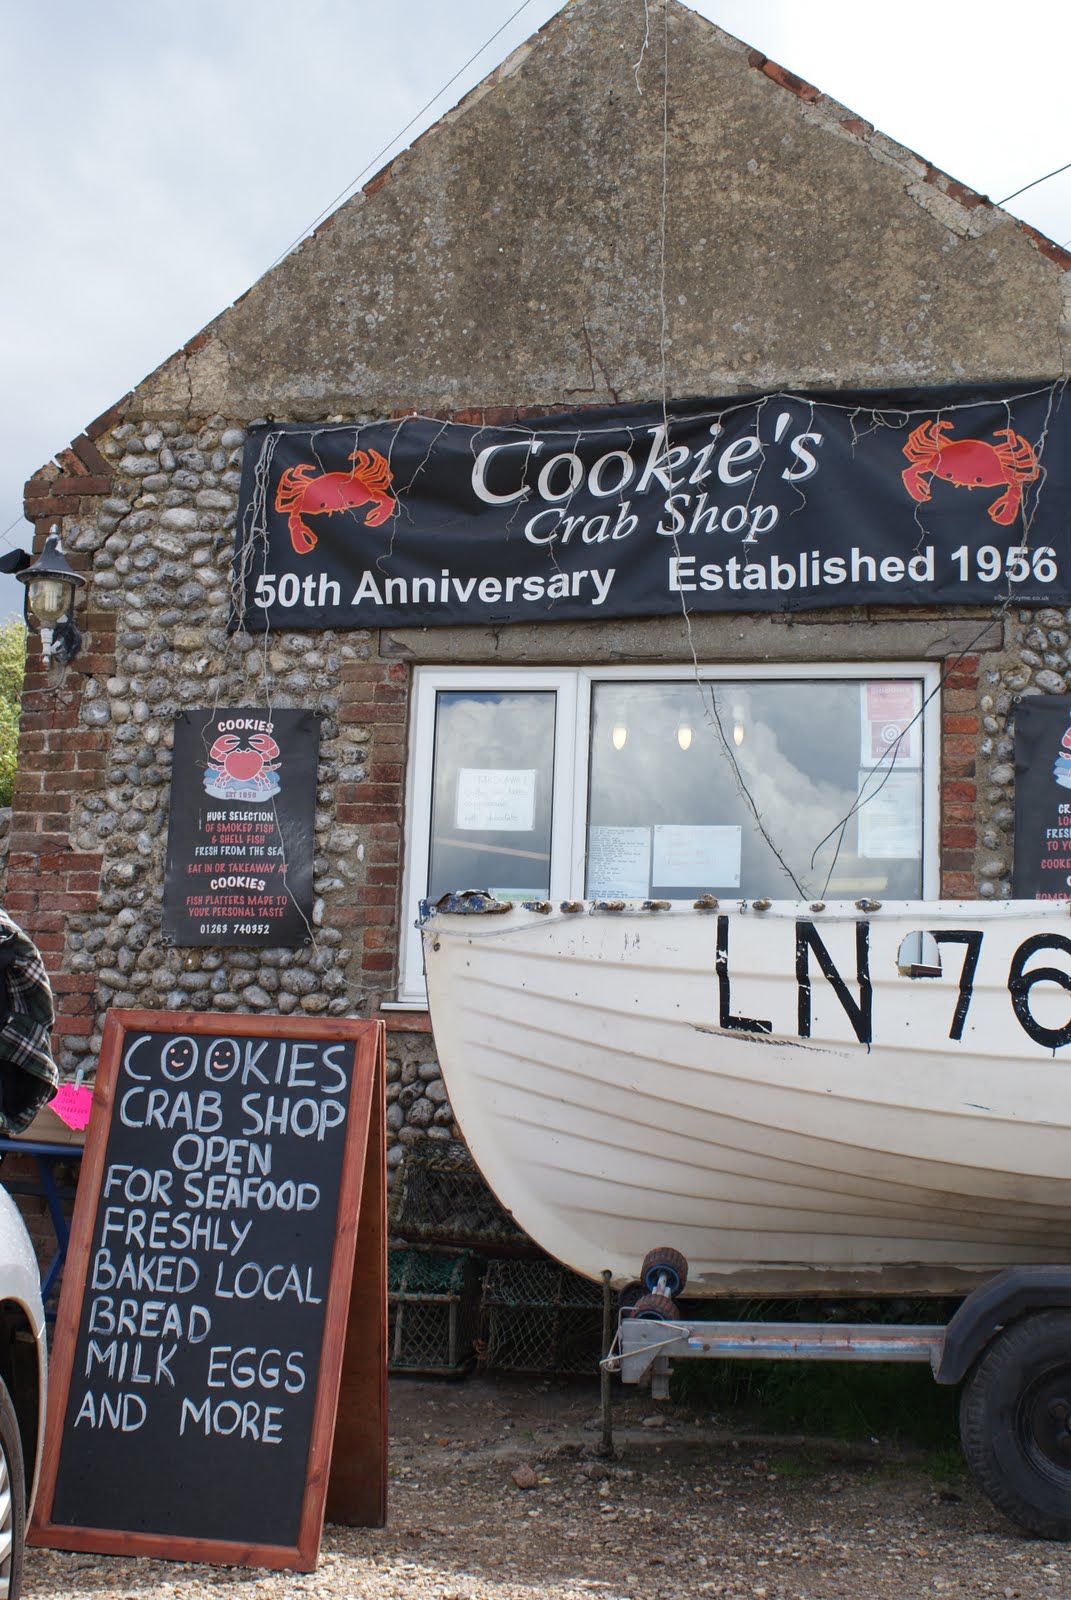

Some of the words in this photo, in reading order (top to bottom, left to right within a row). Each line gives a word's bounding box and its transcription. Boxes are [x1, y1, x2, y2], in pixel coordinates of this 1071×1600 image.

[471, 412, 824, 506] Cookie's
[523, 501, 639, 545] Crab
[656, 493, 779, 543] Shop
[253, 572, 341, 608] 50th
[352, 568, 616, 605] Anniversary
[668, 545, 935, 592] Established
[950, 545, 1058, 583] 1956
[217, 718, 274, 734] COOKIES
[205, 823, 214, 833] OF
[216, 823, 253, 833] SMOKED
[255, 823, 274, 833] FISH
[207, 811, 227, 821] HUGE
[229, 811, 274, 821] SELECTION
[1058, 803, 1071, 814] CR
[1058, 816, 1071, 826] LO
[195, 846, 218, 856] FRESH
[220, 845, 246, 856] FROM
[249, 846, 264, 856] THE
[267, 846, 284, 856] SEA
[211, 835, 217, 844] &
[219, 834, 243, 844] SHELL
[246, 834, 265, 844] FISH
[1047, 841, 1059, 851] TO
[188, 863, 202, 873] EAT
[204, 863, 213, 873] IN
[215, 863, 225, 873] OR
[228, 863, 275, 873] TAKEAWAY
[278, 863, 289, 873] AT
[210, 876, 266, 891] COOKIES
[186, 895, 203, 905] FISH
[205, 895, 245, 905] PLATTERS
[247, 895, 274, 905] MADE
[276, 895, 288, 905] TO
[188, 907, 210, 917] YOUR
[212, 907, 256, 917] PERSONAL
[258, 907, 285, 917] TASTE
[200, 923, 228, 934] 01263
[233, 924, 270, 934] 740352
[715, 915, 873, 1044] LN
[124, 1035, 347, 1093] COOKIES
[120, 1086, 223, 1132] CRAB
[241, 1092, 346, 1141] SHOP
[172, 1133, 272, 1175] OPEN
[103, 1164, 173, 1206] FOR
[183, 1171, 321, 1212] SEAFOOD
[101, 1206, 252, 1256] FRESHLY
[91, 1248, 200, 1293] BAKED
[214, 1261, 322, 1304] LOCAL
[88, 1295, 212, 1343] BREAD
[85, 1339, 178, 1387] MILK
[207, 1346, 306, 1393] EGGS
[73, 1389, 147, 1432] AND
[179, 1396, 285, 1444] MORE
